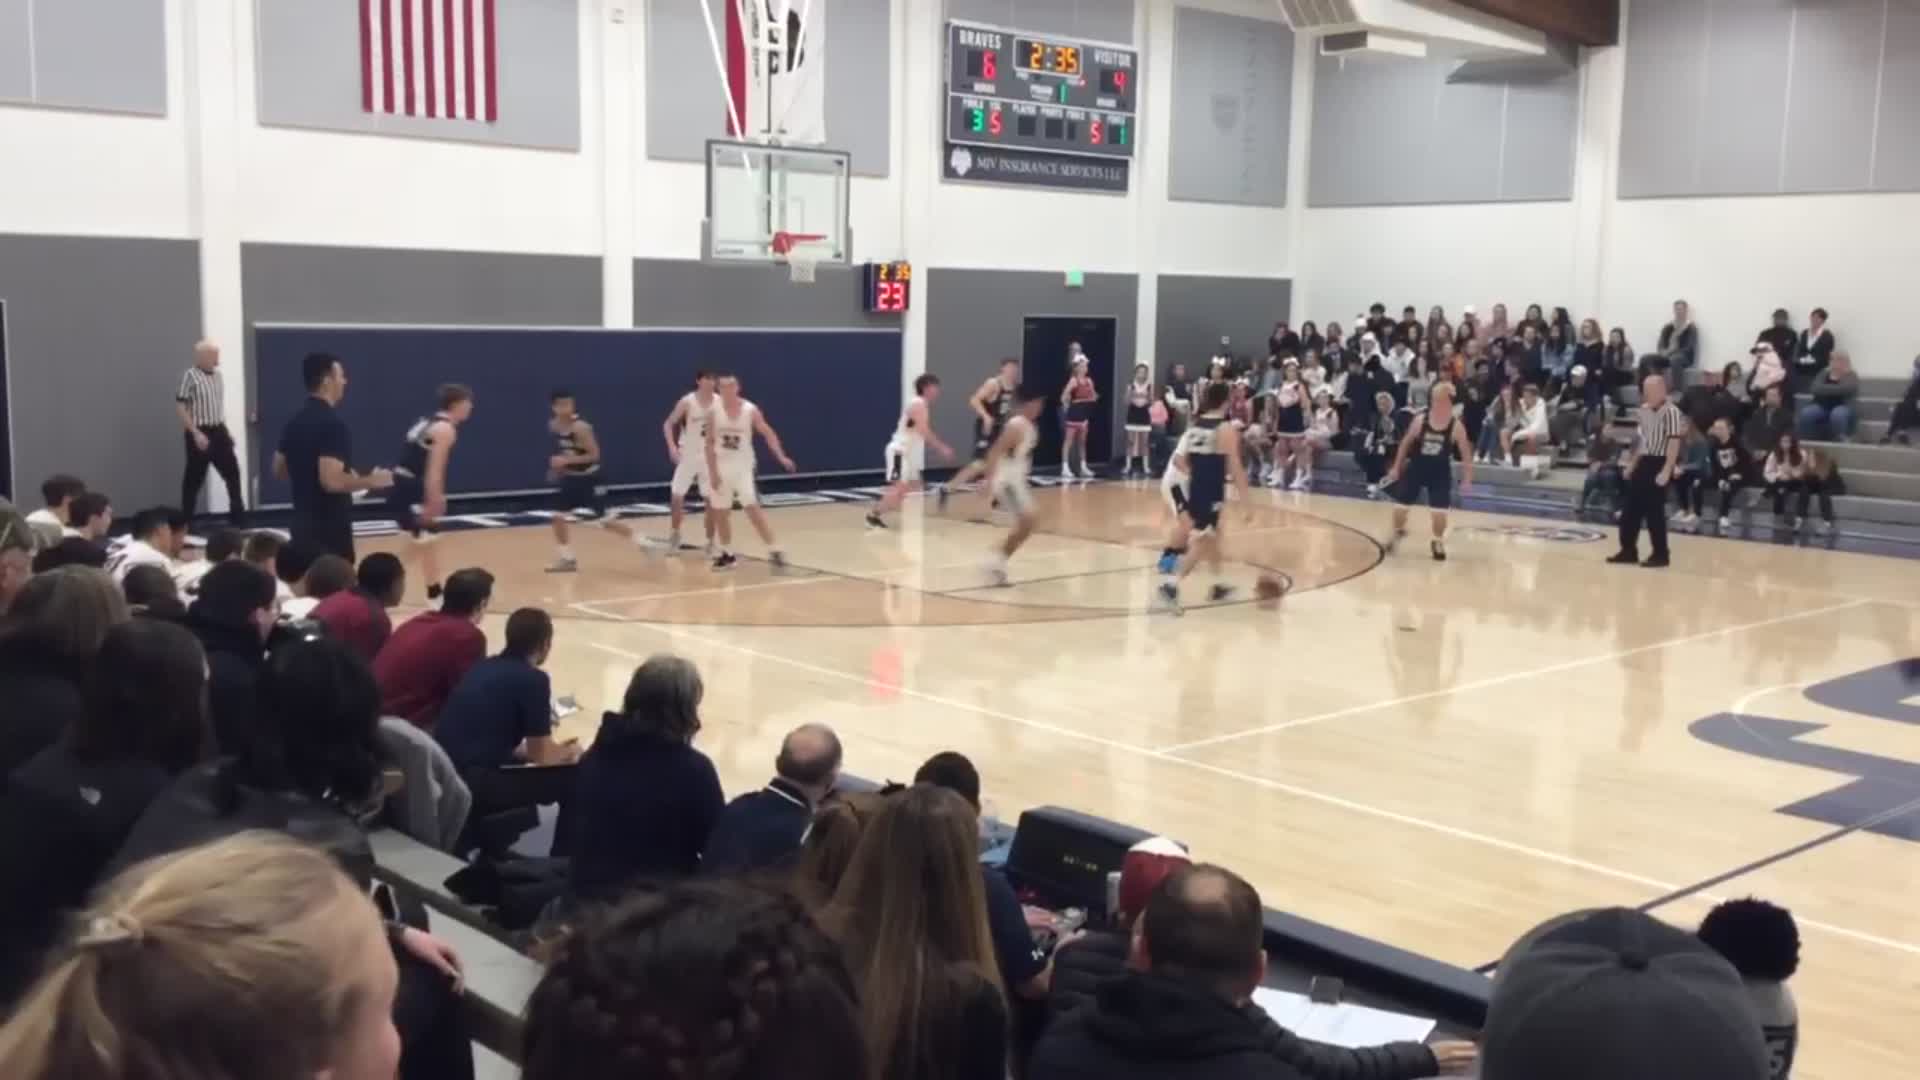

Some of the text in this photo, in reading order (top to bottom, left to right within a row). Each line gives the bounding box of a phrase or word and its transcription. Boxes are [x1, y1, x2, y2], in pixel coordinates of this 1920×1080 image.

[959, 30, 1001, 49] BRAVES
[982, 50, 997, 80] 6
[1029, 43, 1077, 73] 2:35
[1094, 51, 1132, 67] VISITOR
[1059, 83, 1068, 103] 1
[1113, 71, 1128, 94] 4
[971, 110, 1002, 134] 3 5
[1090, 122, 1102, 144] 5
[999, 159, 1057, 176] INSURANCE
[1059, 163, 1104, 179] SERVICES
[877, 282, 905, 311] 23
